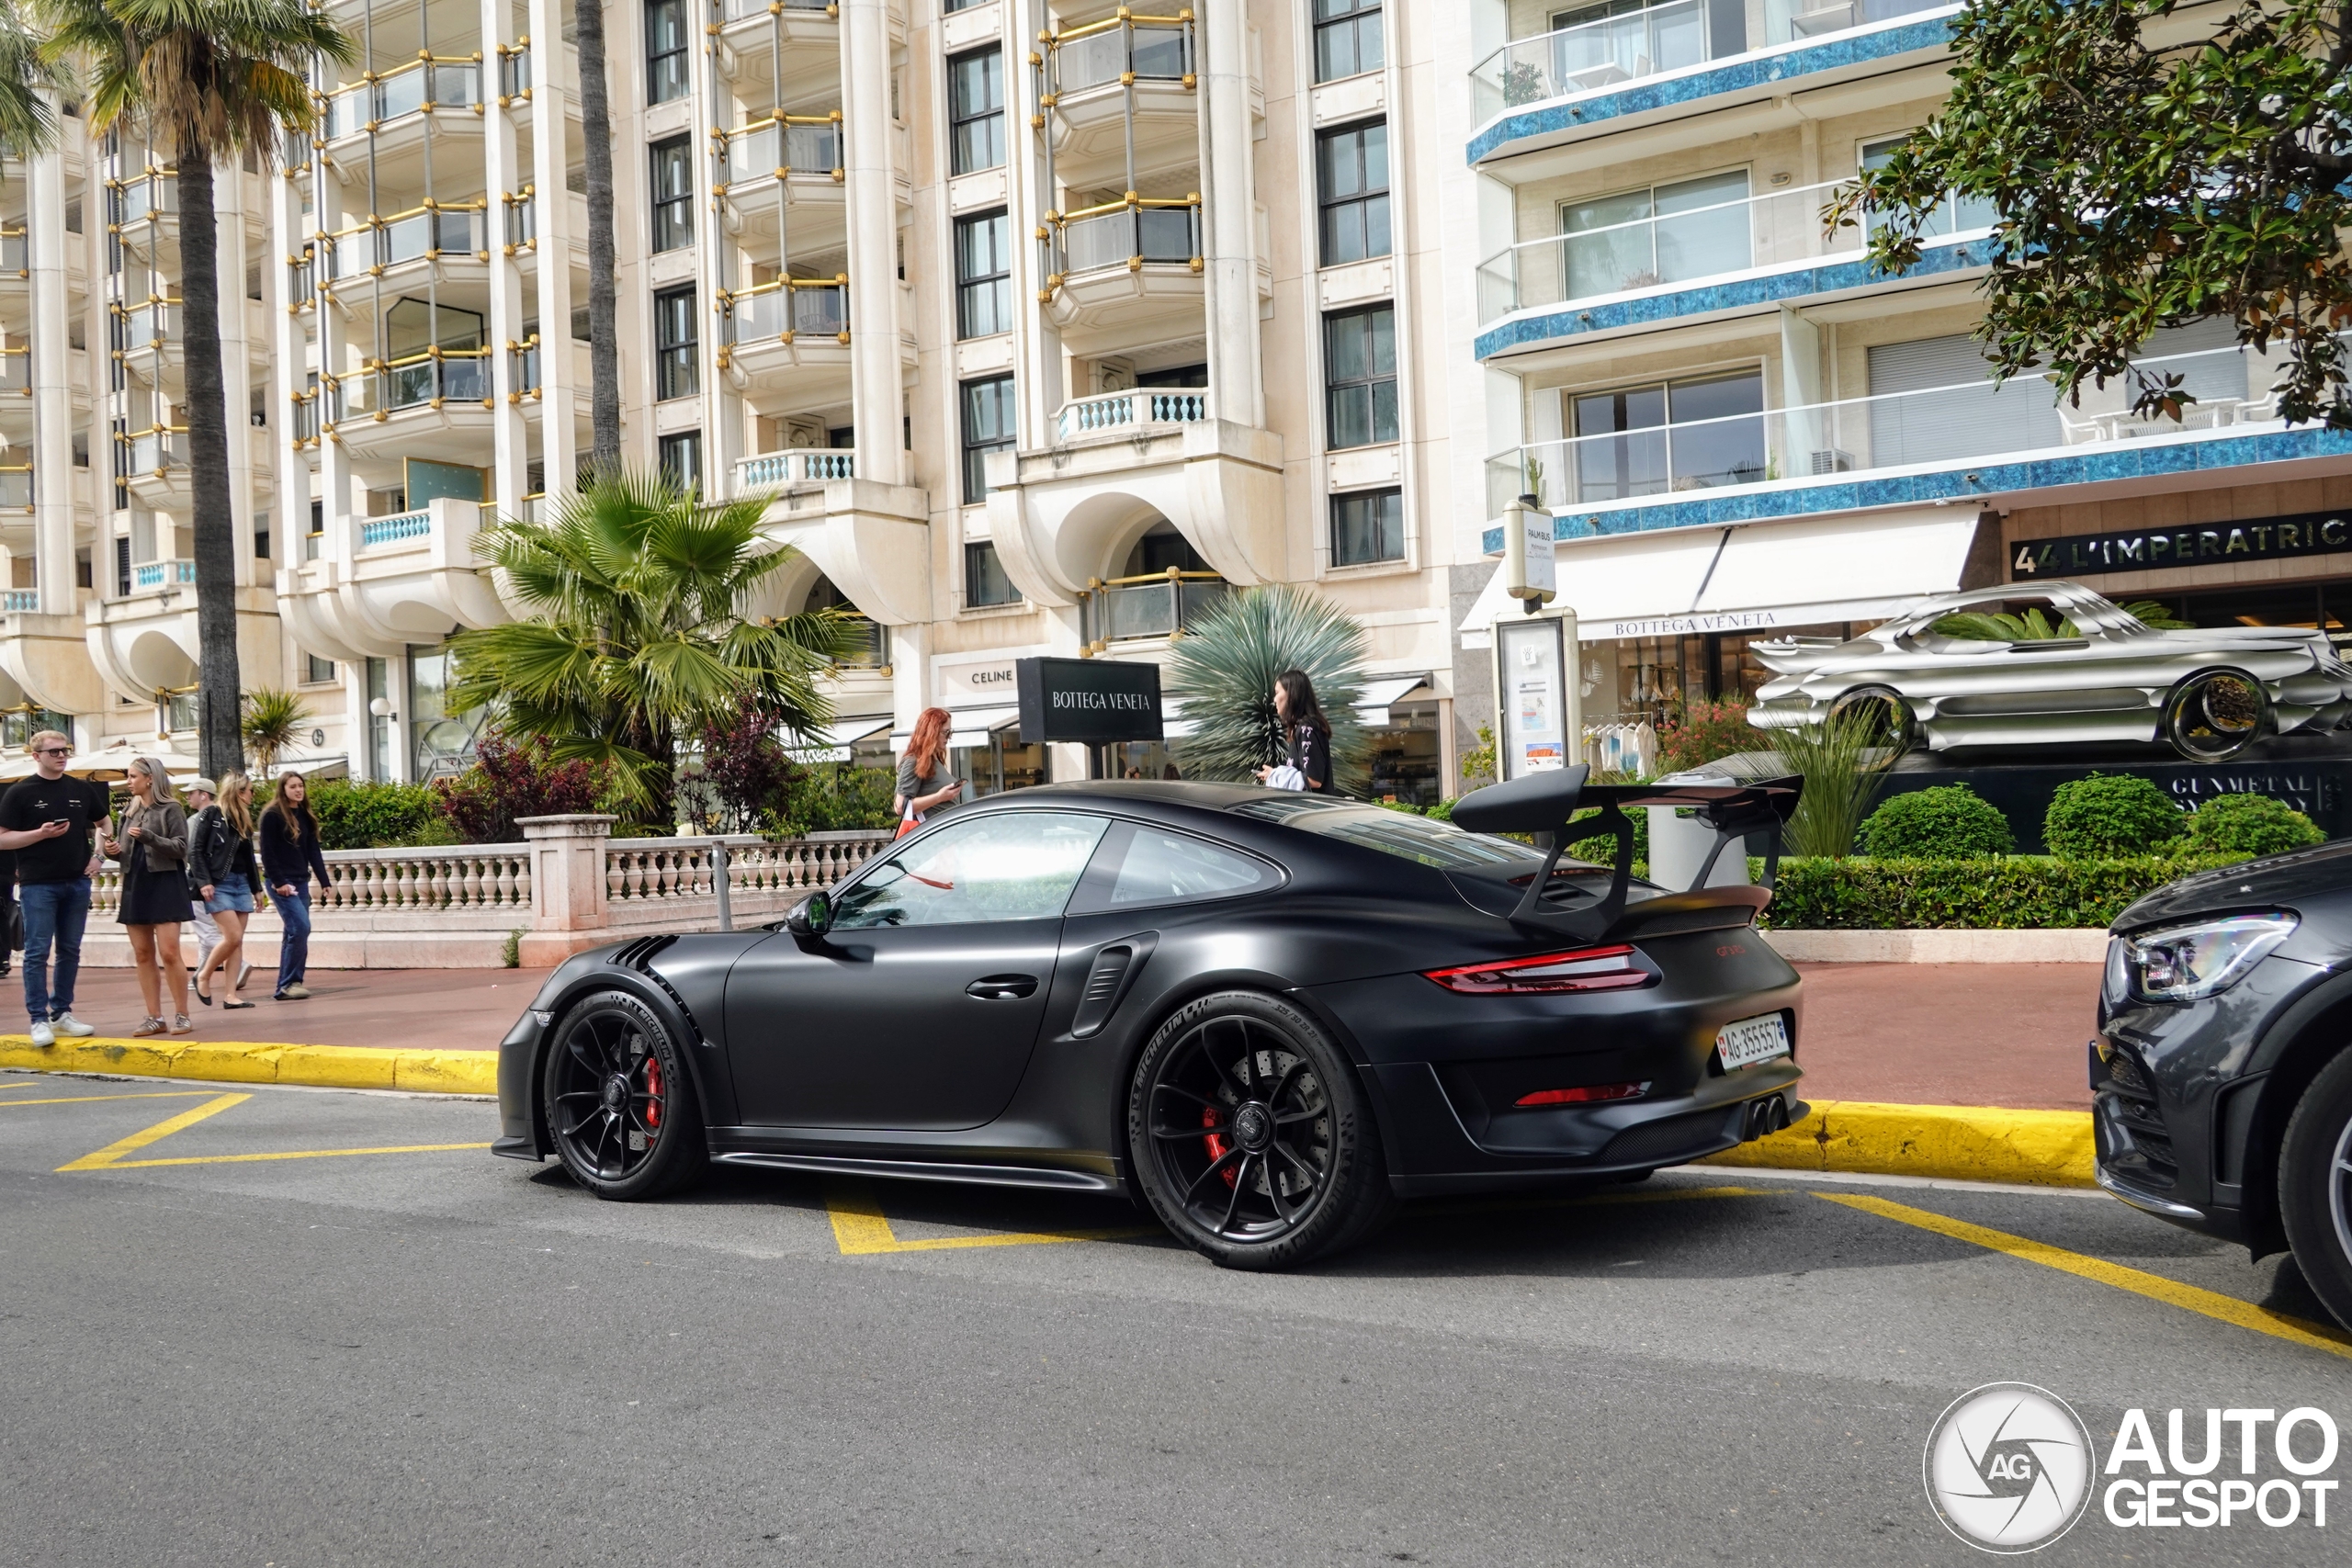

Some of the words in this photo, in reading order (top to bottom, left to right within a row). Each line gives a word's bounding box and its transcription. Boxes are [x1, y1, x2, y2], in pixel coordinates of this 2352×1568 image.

[1528, 529, 1541, 539] PALM
[1542, 532, 1550, 541] BUS
[2015, 543, 2061, 573] 44
[1614, 618, 1696, 636] BOTTEGA
[1702, 612, 1776, 629] VENETA
[971, 670, 1012, 683] CELINE
[1053, 691, 1106, 709] BOTTEGA
[1109, 693, 1150, 710] VENETA
[2172, 775, 2311, 795] GUNMETAL
[639, 1010, 671, 1060] MICHELIN
[1136, 1012, 1184, 1089] MICHELIN
[1294, 1171, 1348, 1250] MICHELIN
